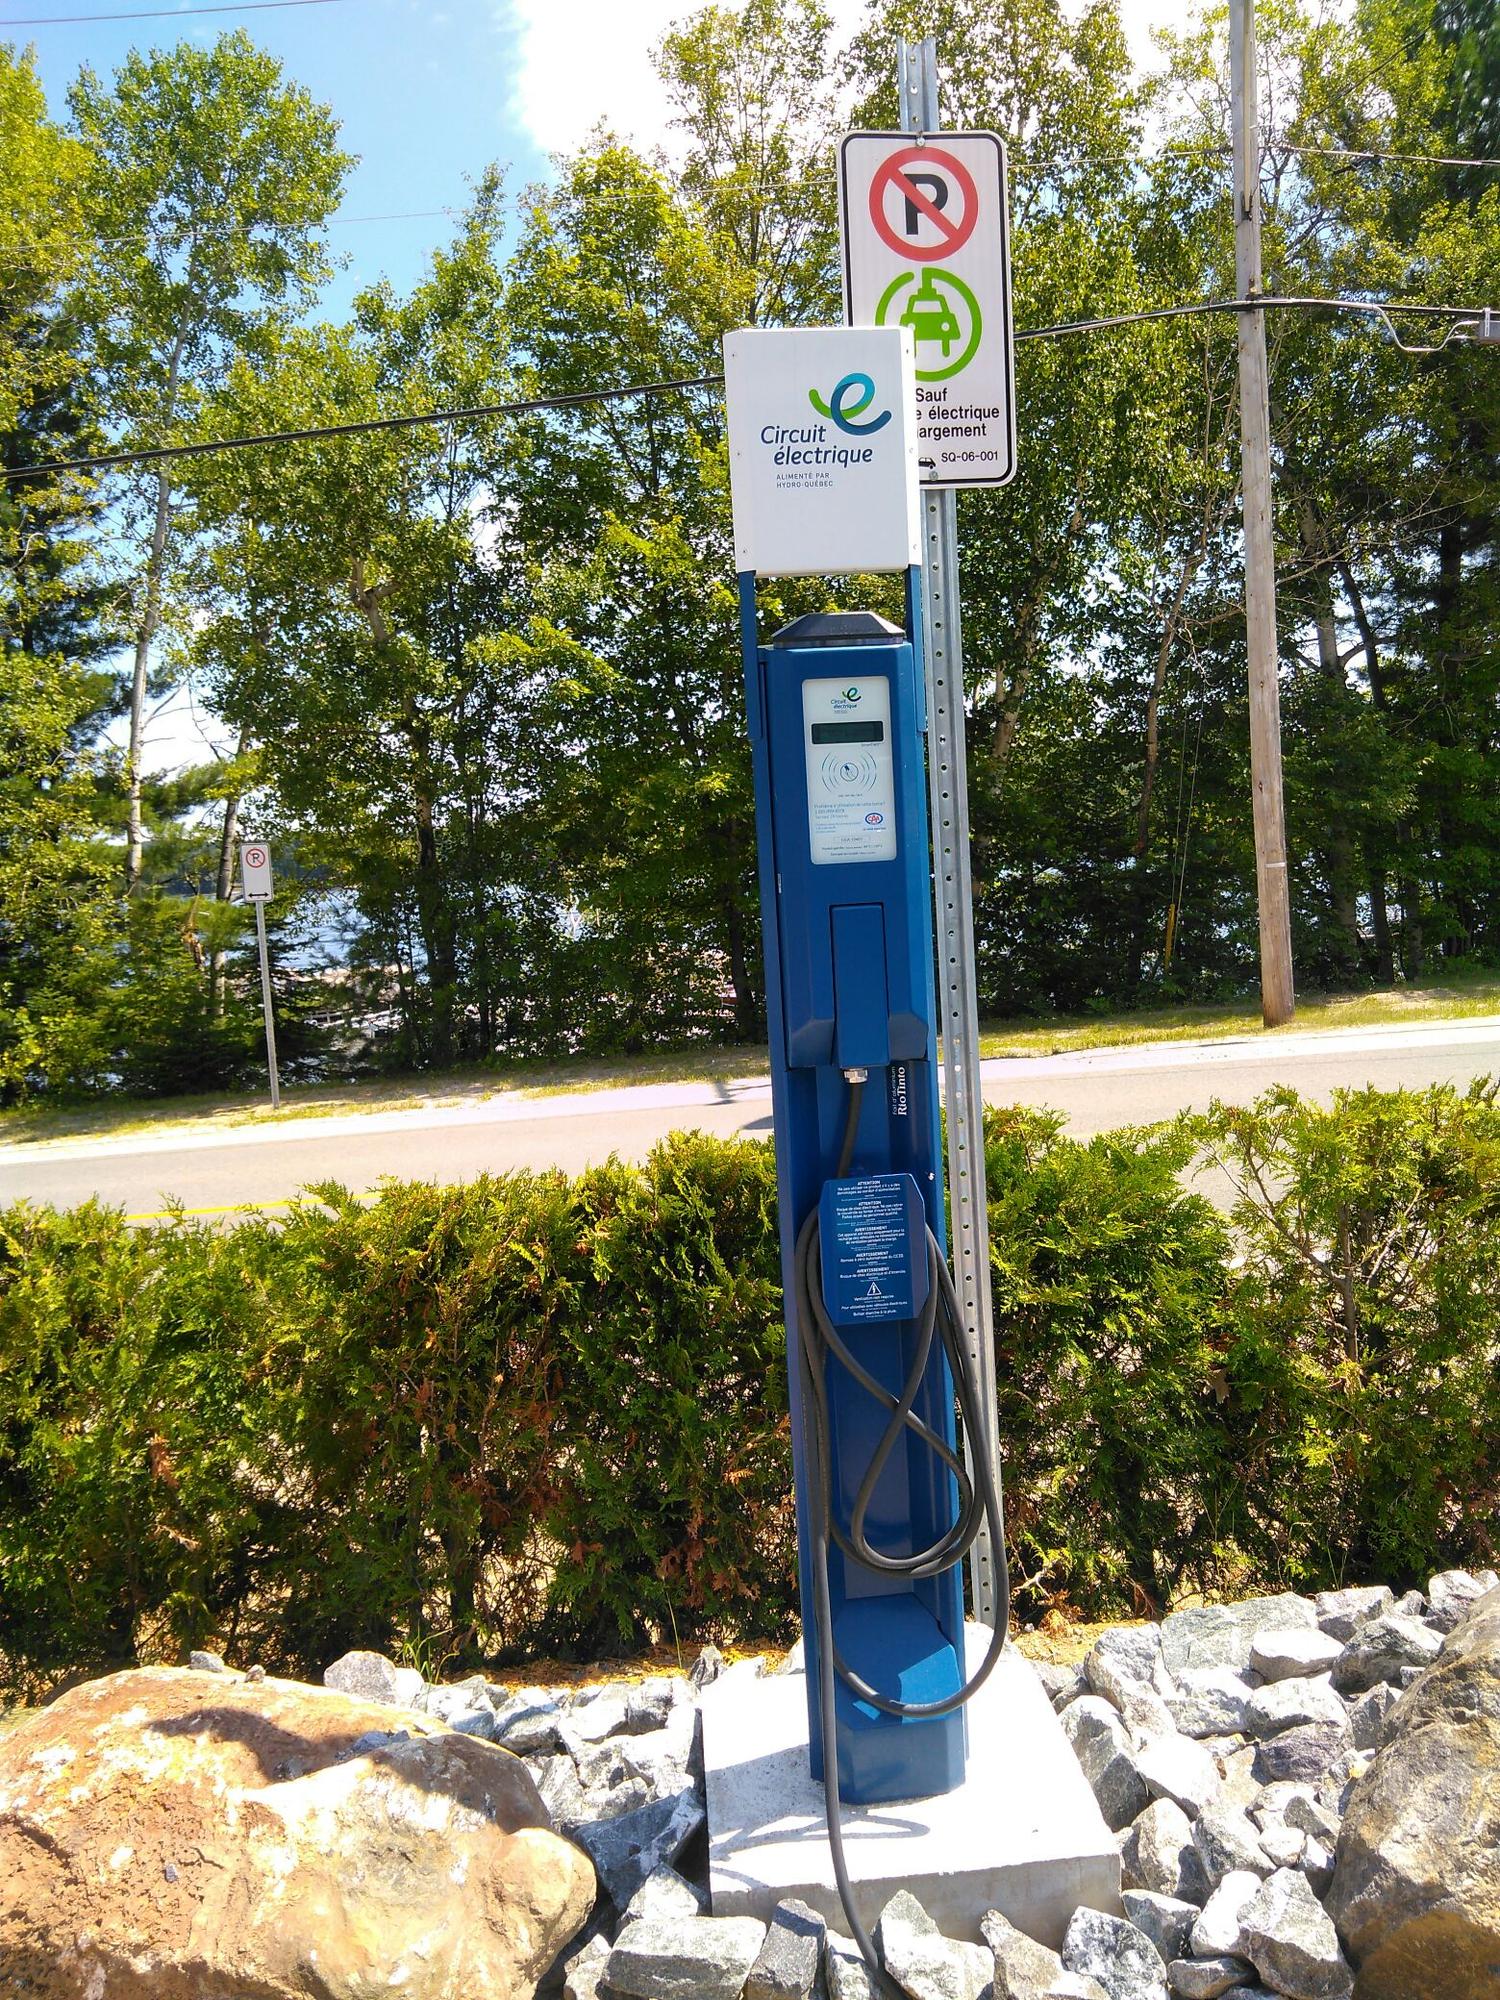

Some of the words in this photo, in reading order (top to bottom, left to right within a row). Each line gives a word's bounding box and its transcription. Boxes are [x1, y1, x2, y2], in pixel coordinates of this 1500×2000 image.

[915, 387, 948, 402] Sauf
[928, 405, 1000, 421] électrique
[760, 424, 827, 444] Circuit
[917, 423, 987, 441] argement
[773, 445, 873, 468] électrique
[941, 450, 999, 463] SQ-06-001
[776, 472, 813, 481] ALIMENTÉ
[815, 472, 830, 480] PAR
